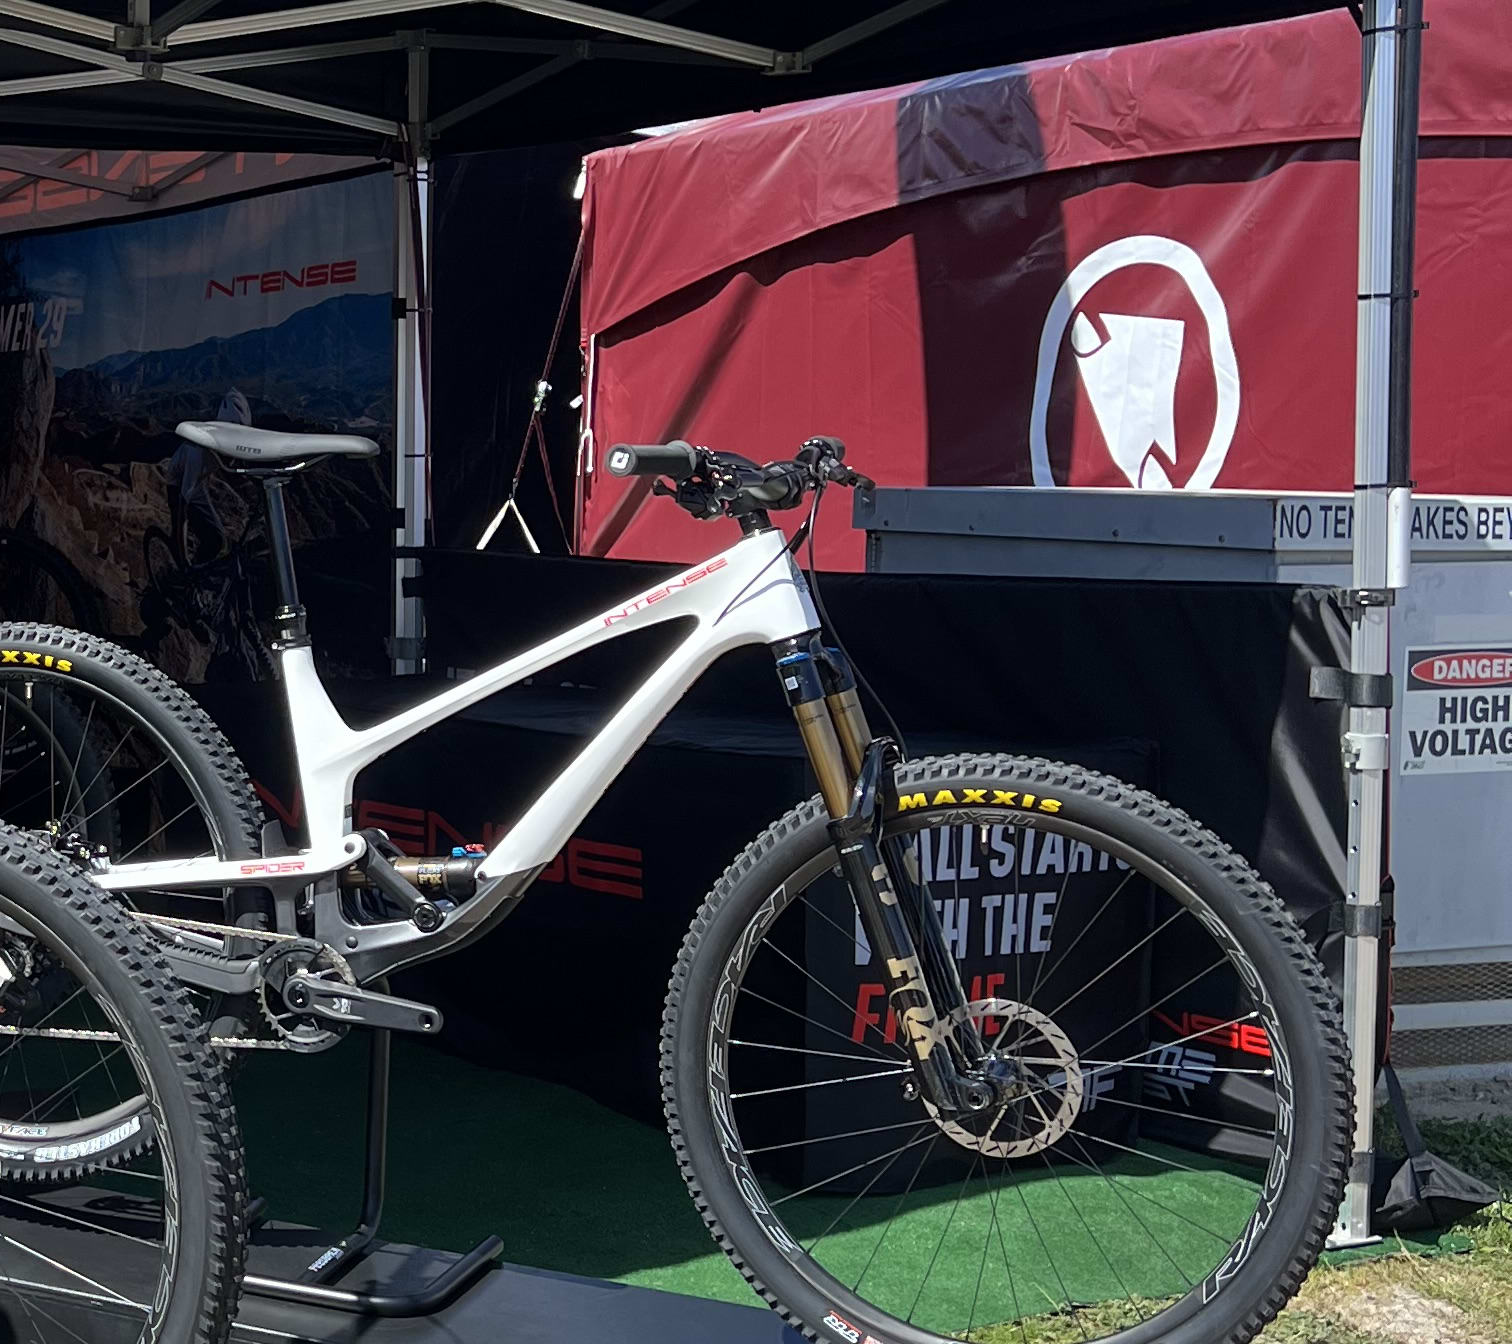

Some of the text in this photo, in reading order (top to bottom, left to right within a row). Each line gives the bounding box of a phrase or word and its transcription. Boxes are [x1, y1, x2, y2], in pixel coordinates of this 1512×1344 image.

[37, 297, 69, 349] 29
[1279, 504, 1313, 539] NO
[1411, 506, 1469, 541] AKES
[602, 557, 728, 627] INTENSE
[1438, 694, 1511, 725] HIGH
[897, 787, 1064, 814] MAXXIS
[240, 861, 306, 875] SPIDER
[981, 892, 1057, 957] THE
